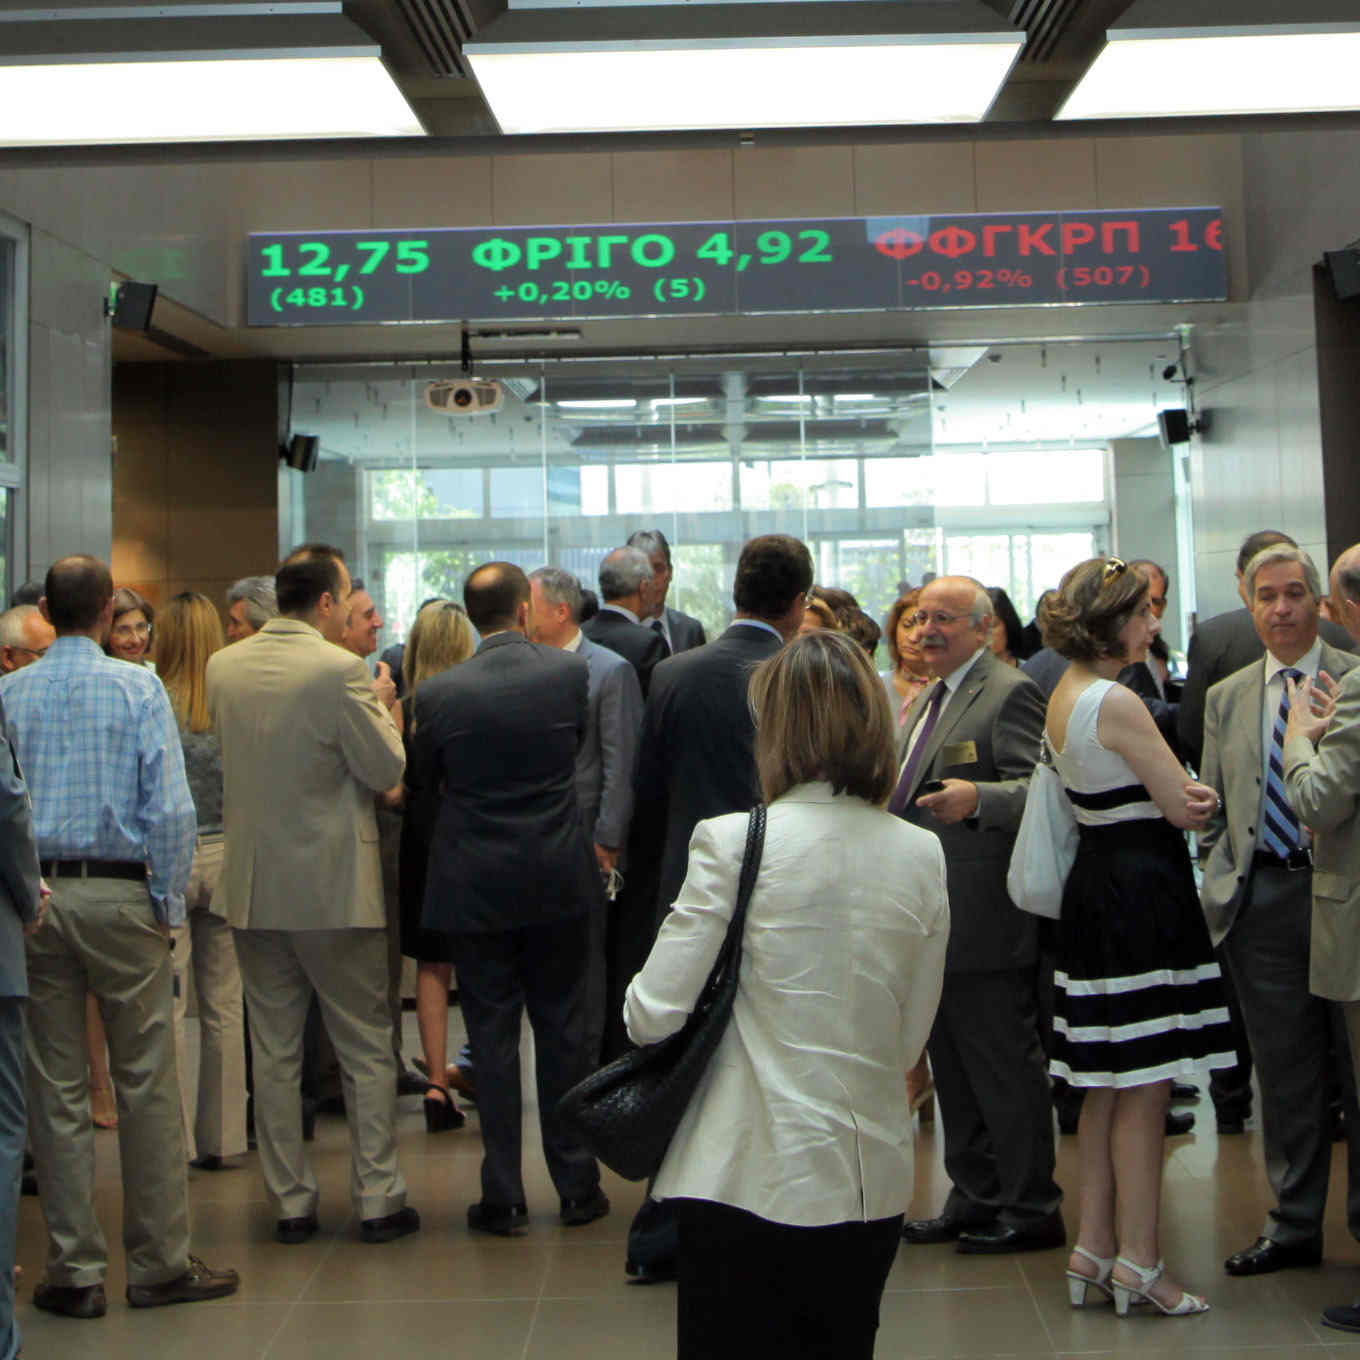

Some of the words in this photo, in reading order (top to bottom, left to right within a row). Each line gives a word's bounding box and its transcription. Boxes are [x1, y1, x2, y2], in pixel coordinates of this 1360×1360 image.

[259, 239, 433, 283] 12,75
[470, 232, 678, 274] ΦΡΙΓΟ
[695, 228, 835, 273] 4,92
[874, 219, 1142, 261] ΦΦΓΚΡΠ
[270, 285, 366, 313] (481)
[493, 278, 634, 305] +0,20%
[651, 276, 708, 303] (5)
[905, 268, 1033, 294] -0,92%
[1056, 264, 1151, 290] (507)
